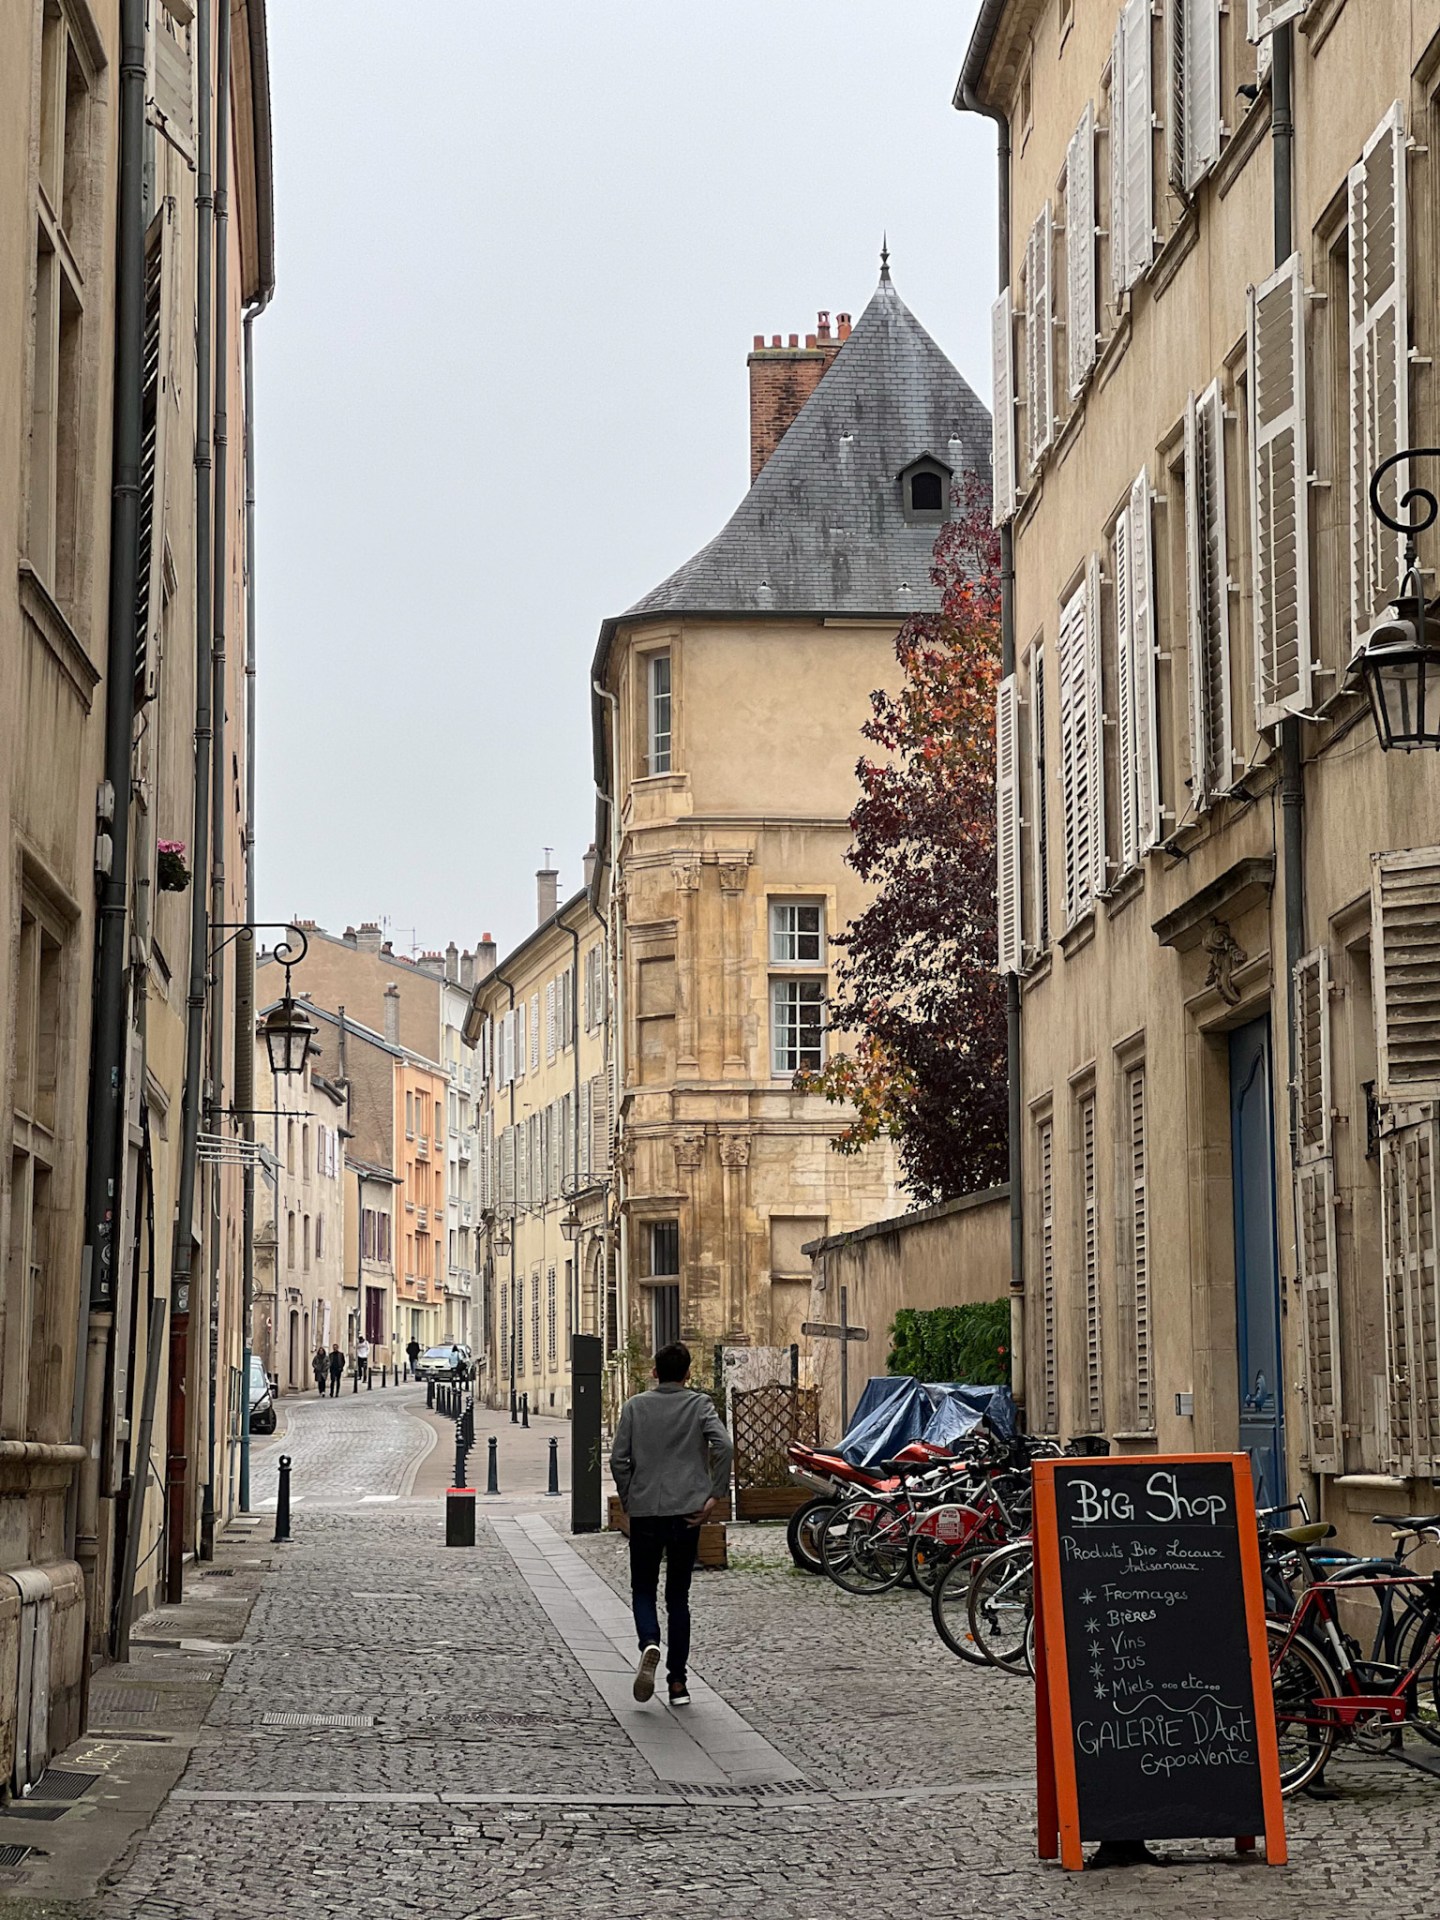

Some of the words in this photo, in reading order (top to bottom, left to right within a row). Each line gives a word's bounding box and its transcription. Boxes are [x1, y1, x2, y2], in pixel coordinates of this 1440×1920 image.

[1146, 1472, 1226, 1525] Shop
[1131, 1540, 1157, 1556] Bio
[1166, 1539, 1225, 1558] Locaux
[1111, 1631, 1146, 1654] Vins
[1112, 1675, 1154, 1698] Miels
